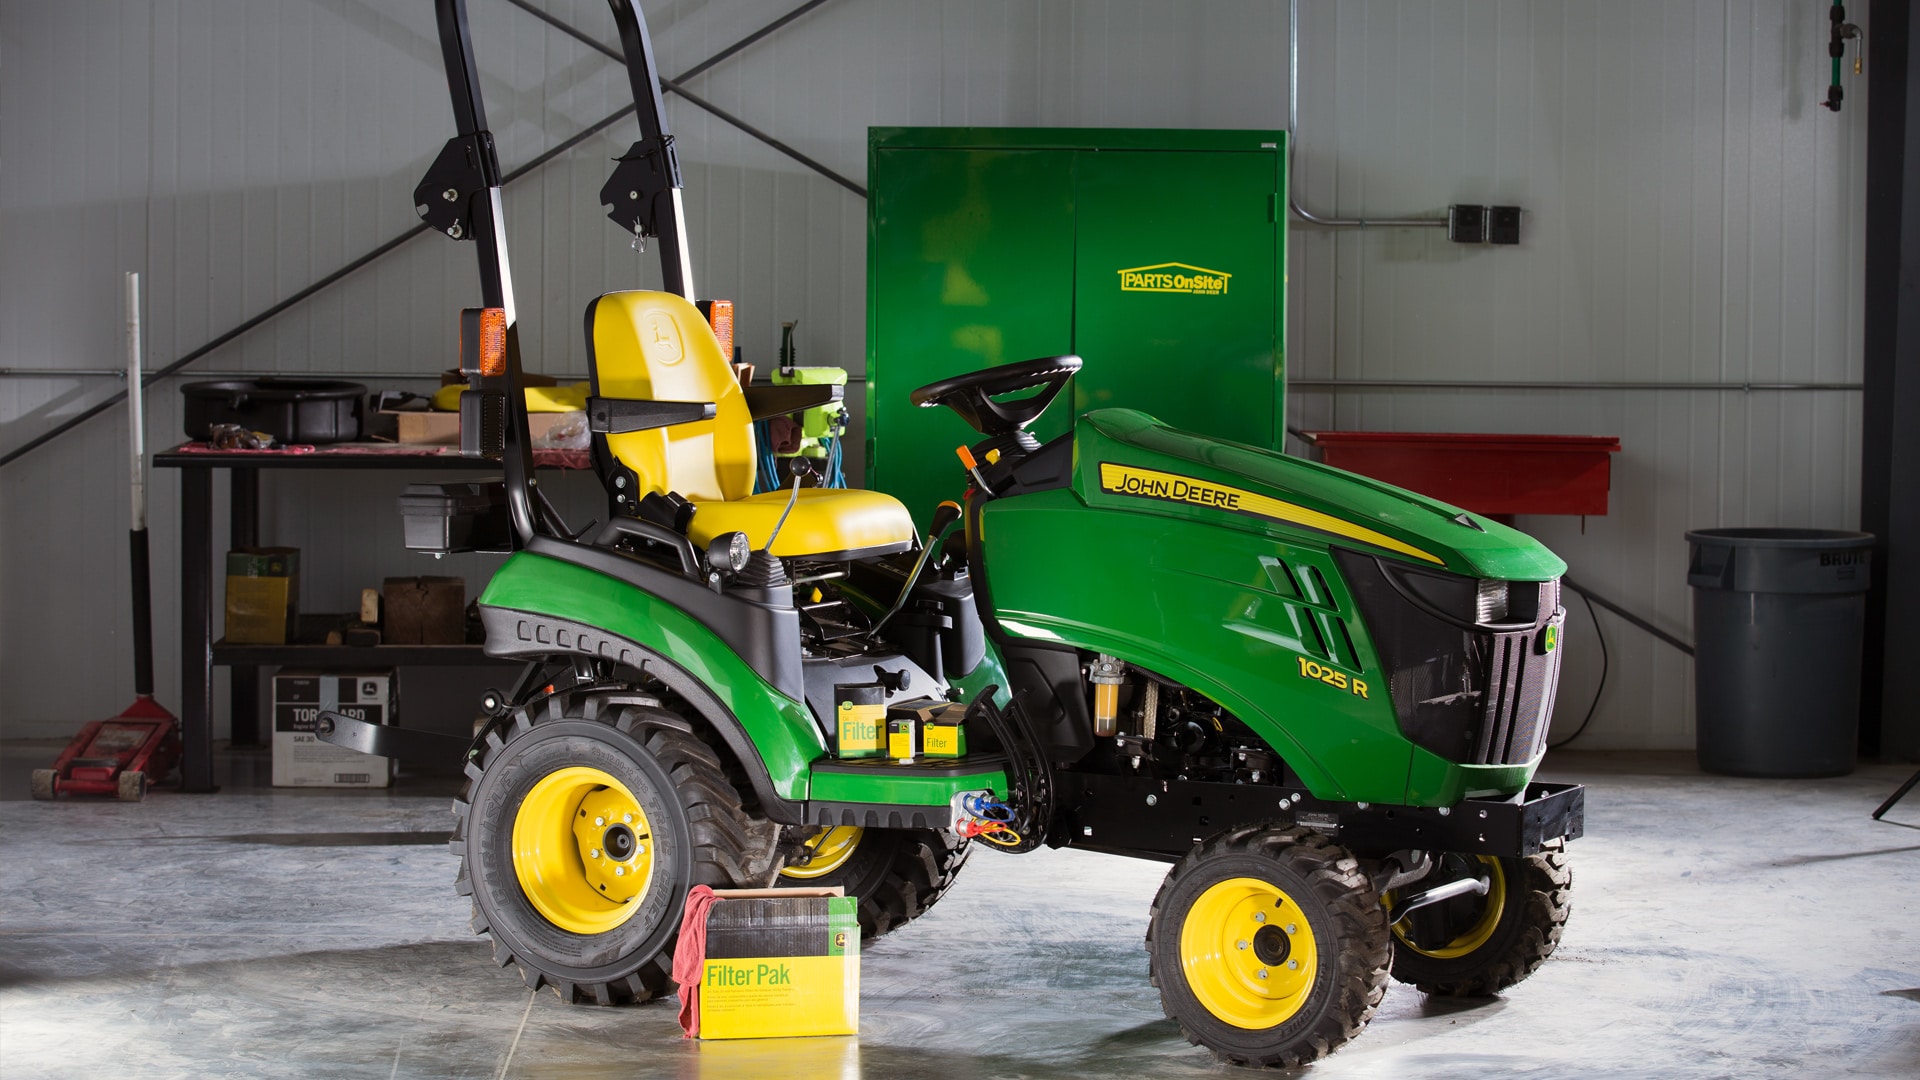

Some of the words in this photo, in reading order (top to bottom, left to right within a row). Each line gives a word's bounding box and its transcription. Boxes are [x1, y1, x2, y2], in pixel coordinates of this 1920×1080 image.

[1125, 273, 1172, 288] PARTS
[1115, 474, 1169, 496] JOHN
[1172, 480, 1241, 509] DEERE
[1297, 656, 1348, 690] 1025
[1352, 678, 1369, 700] R
[843, 721, 883, 741] Filter
[926, 737, 948, 748] Filter
[482, 770, 518, 906] CARLISLE
[707, 965, 754, 987] Filter
[757, 963, 791, 985] Pak
